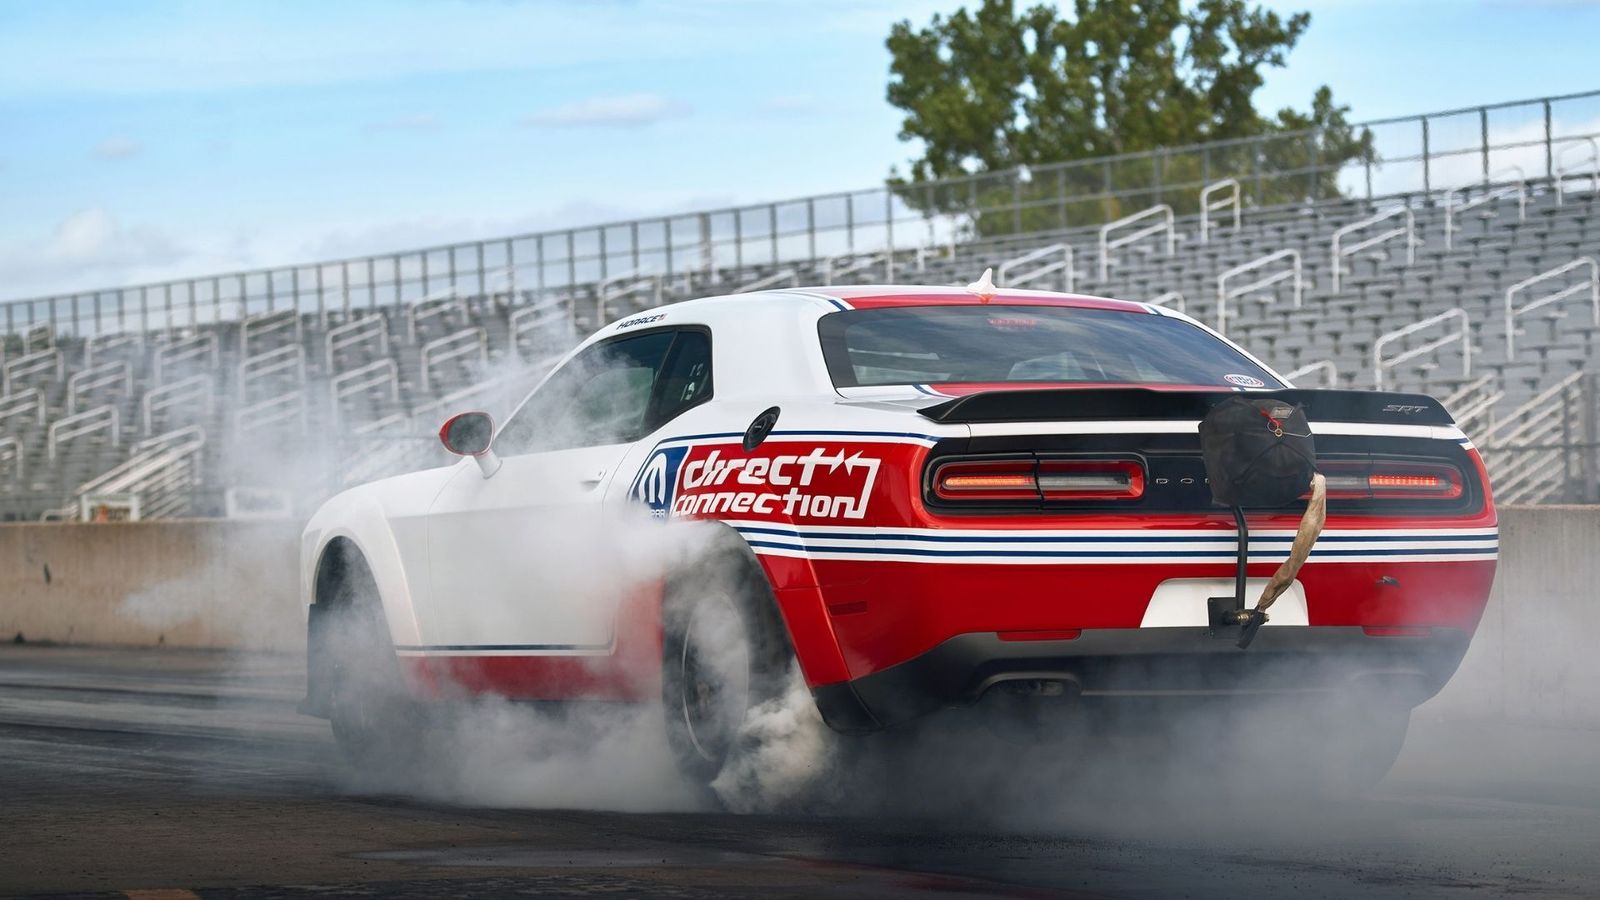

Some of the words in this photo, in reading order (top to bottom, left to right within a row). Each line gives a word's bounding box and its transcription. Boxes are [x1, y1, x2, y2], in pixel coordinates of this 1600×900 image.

[1382, 404, 1429, 414] SRT
[684, 448, 844, 490] direct
[672, 488, 870, 519] connection
